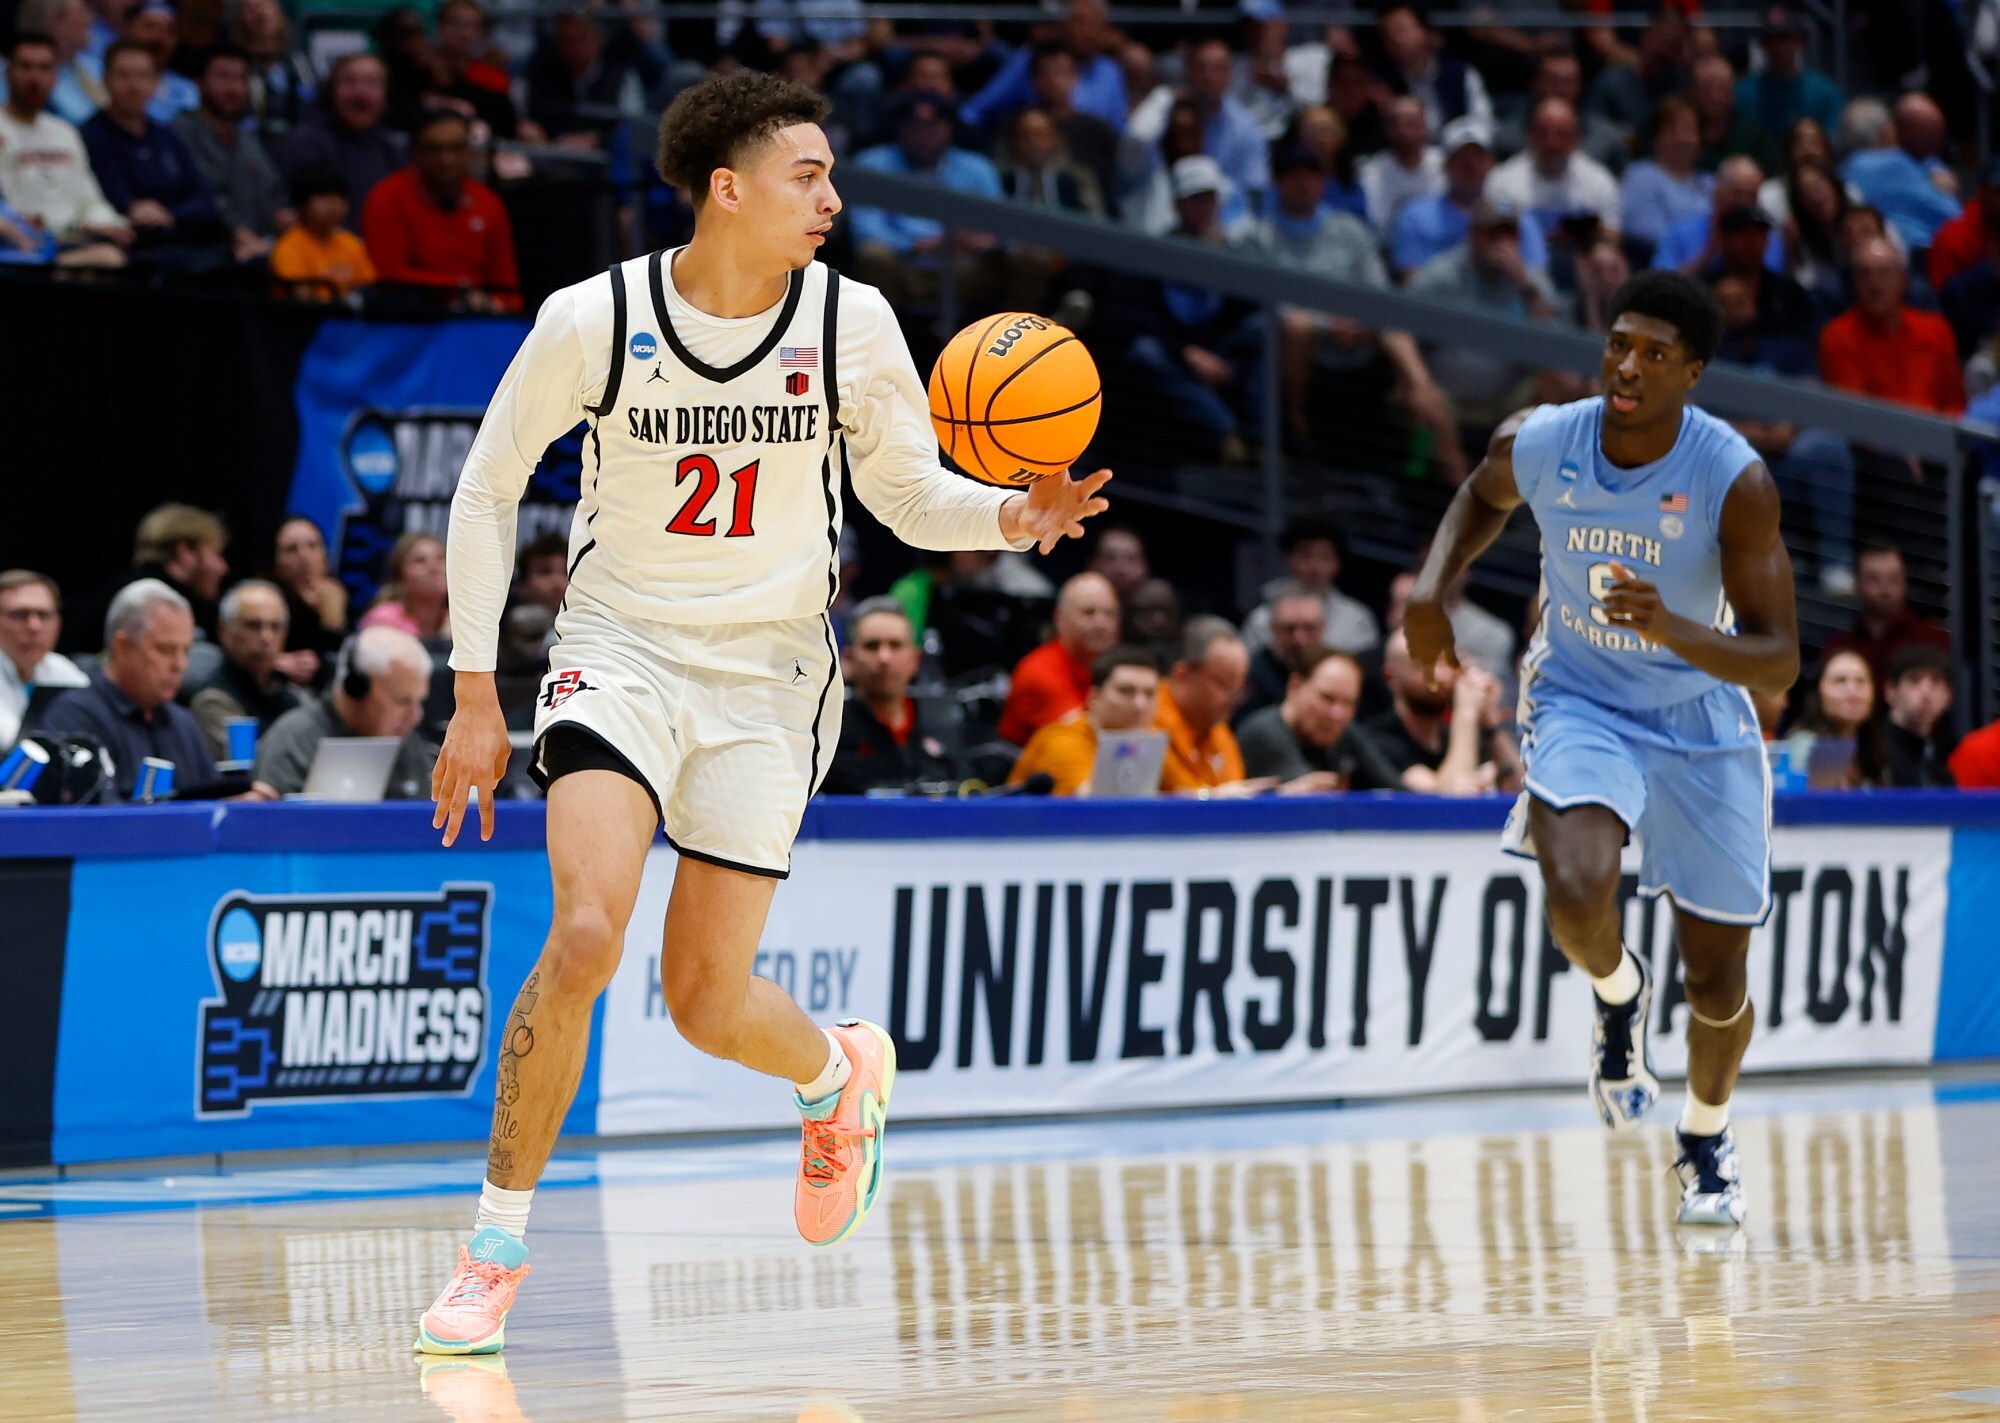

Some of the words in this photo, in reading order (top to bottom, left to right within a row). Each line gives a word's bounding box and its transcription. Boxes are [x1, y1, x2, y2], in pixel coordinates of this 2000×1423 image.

[632, 344, 656, 354] NCAA
[628, 406, 669, 445] SAN
[675, 405, 747, 445] DIEGO
[751, 404, 820, 444] STATE
[665, 453, 761, 538] 21
[1565, 526, 1663, 568] NORTH
[260, 909, 413, 988] MARCH
[809, 948, 859, 1012] BY
[889, 876, 1449, 1071] UNIVERSITY
[281, 987, 484, 1068] MADNESS
